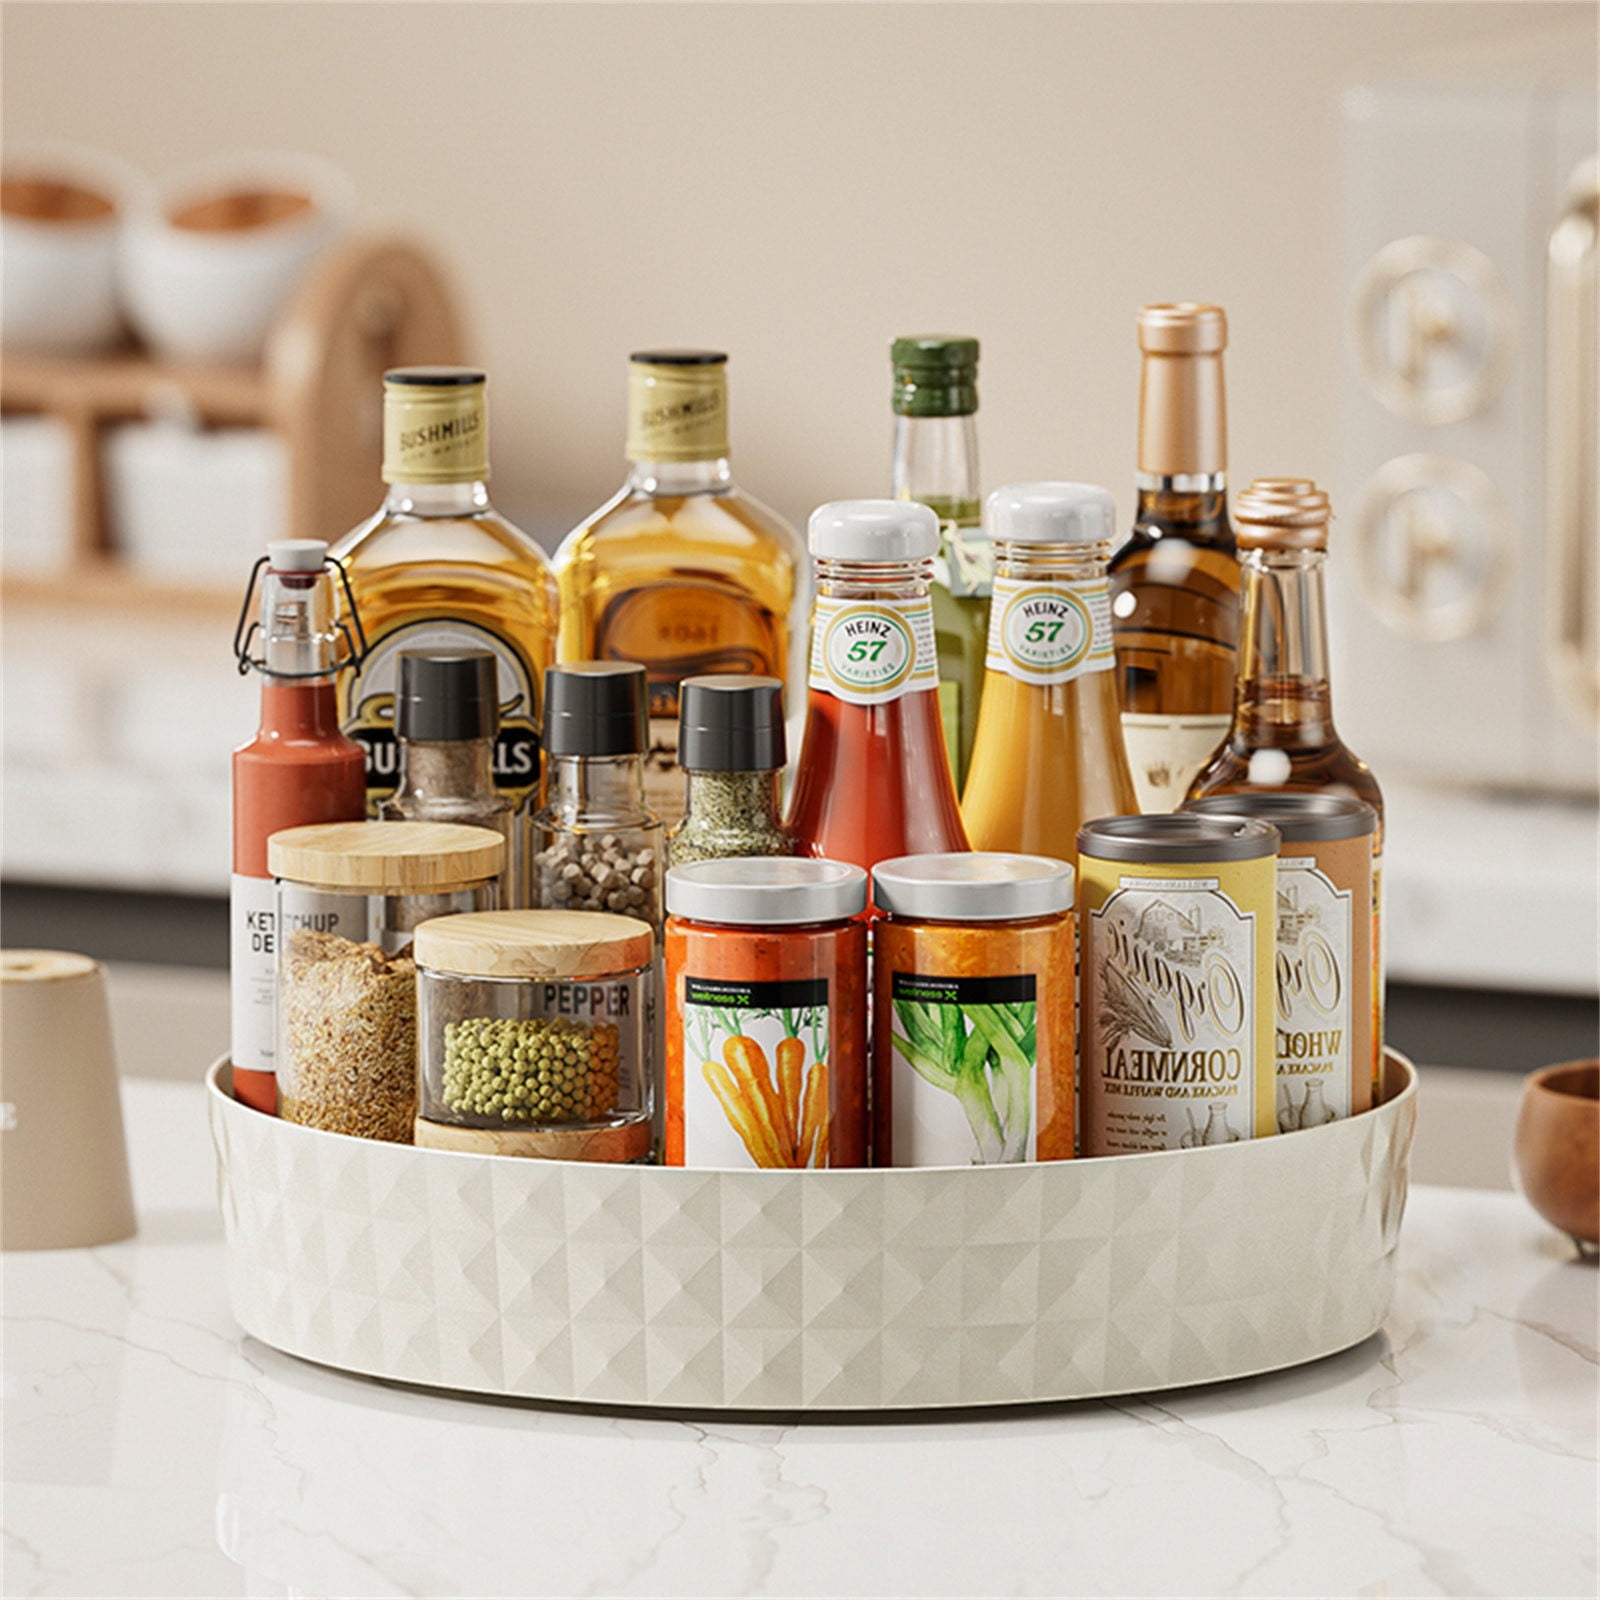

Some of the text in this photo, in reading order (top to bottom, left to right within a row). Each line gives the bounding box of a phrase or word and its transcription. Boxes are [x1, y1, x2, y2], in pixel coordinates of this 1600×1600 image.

[1022, 601, 1069, 619] HEINZ
[844, 620, 892, 639] HEINZ
[1025, 621, 1065, 643] 57
[846, 641, 888, 662] 57
[841, 662, 895, 678] VARIETIES
[543, 983, 630, 1016] PEPPER
